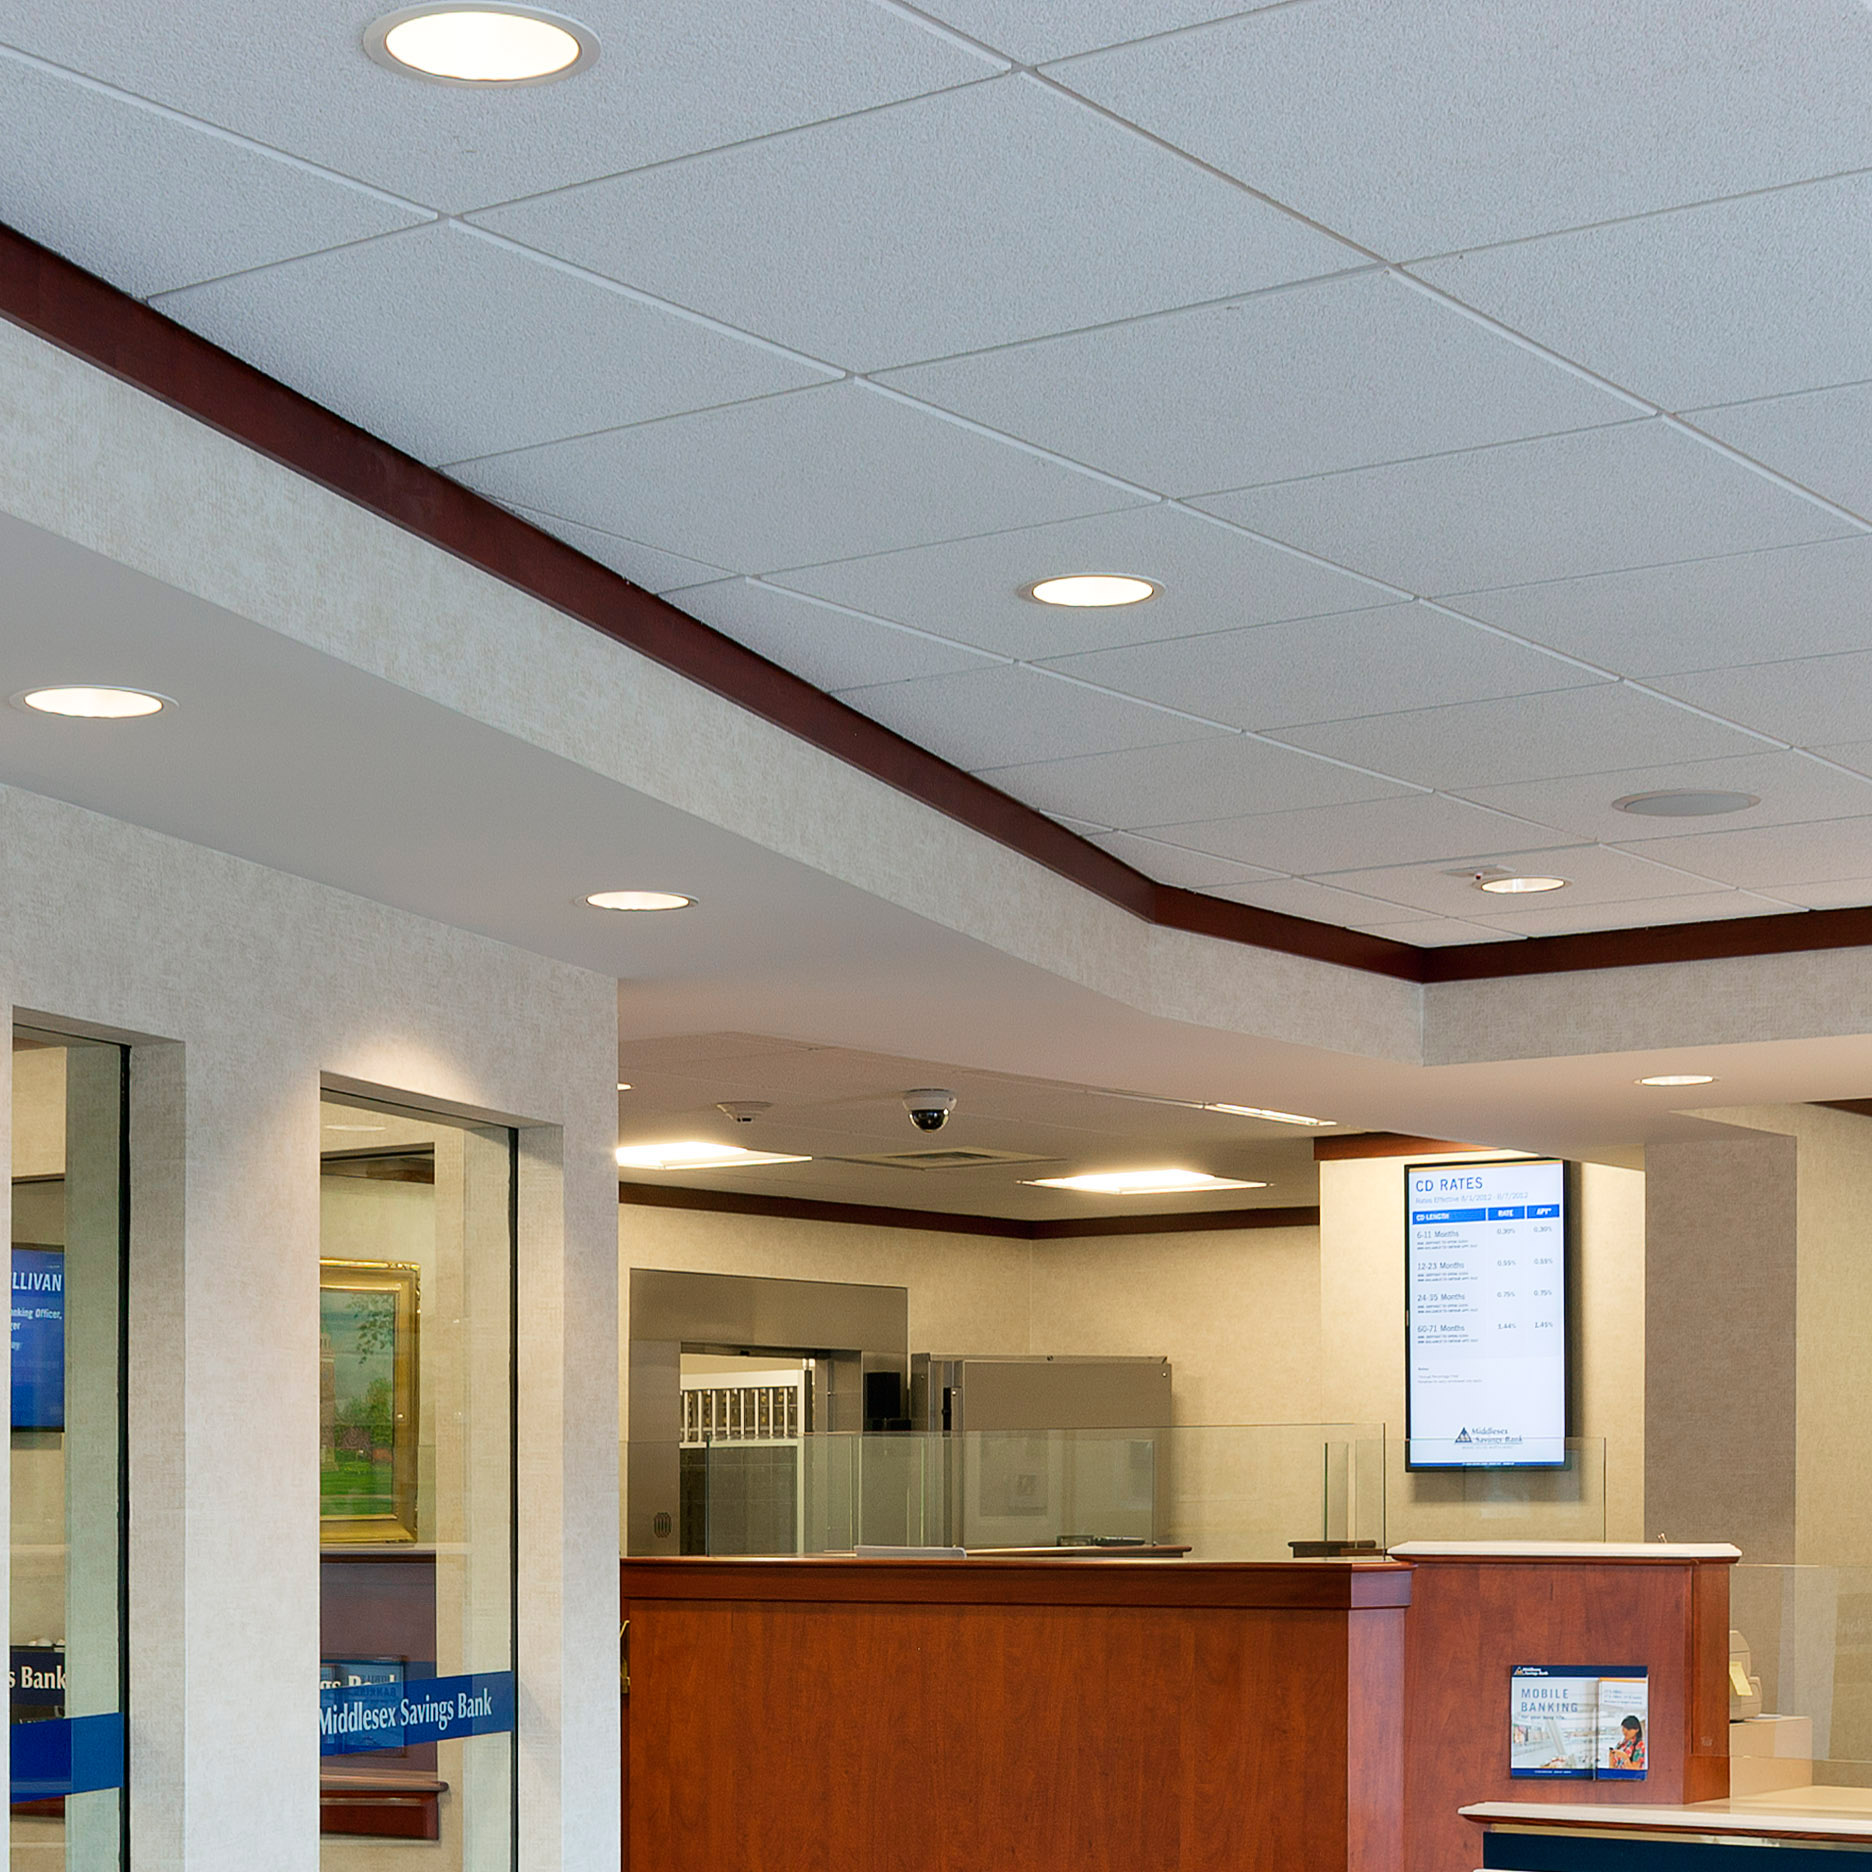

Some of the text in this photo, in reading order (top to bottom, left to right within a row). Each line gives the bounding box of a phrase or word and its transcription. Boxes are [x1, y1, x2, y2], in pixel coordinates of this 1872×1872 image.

[1415, 1176, 1483, 1192] CD RATES
[1434, 1230, 1459, 1238] Months
[1439, 1261, 1464, 1269] Months
[1440, 1293, 1465, 1301] Months
[1440, 1324, 1465, 1332] Months
[21, 1665, 66, 1689] Bank
[1521, 1688, 1568, 1699] MOBILE
[319, 1688, 492, 1736] Middlesex Savings Bank
[1521, 1702, 1578, 1713] BANKING
